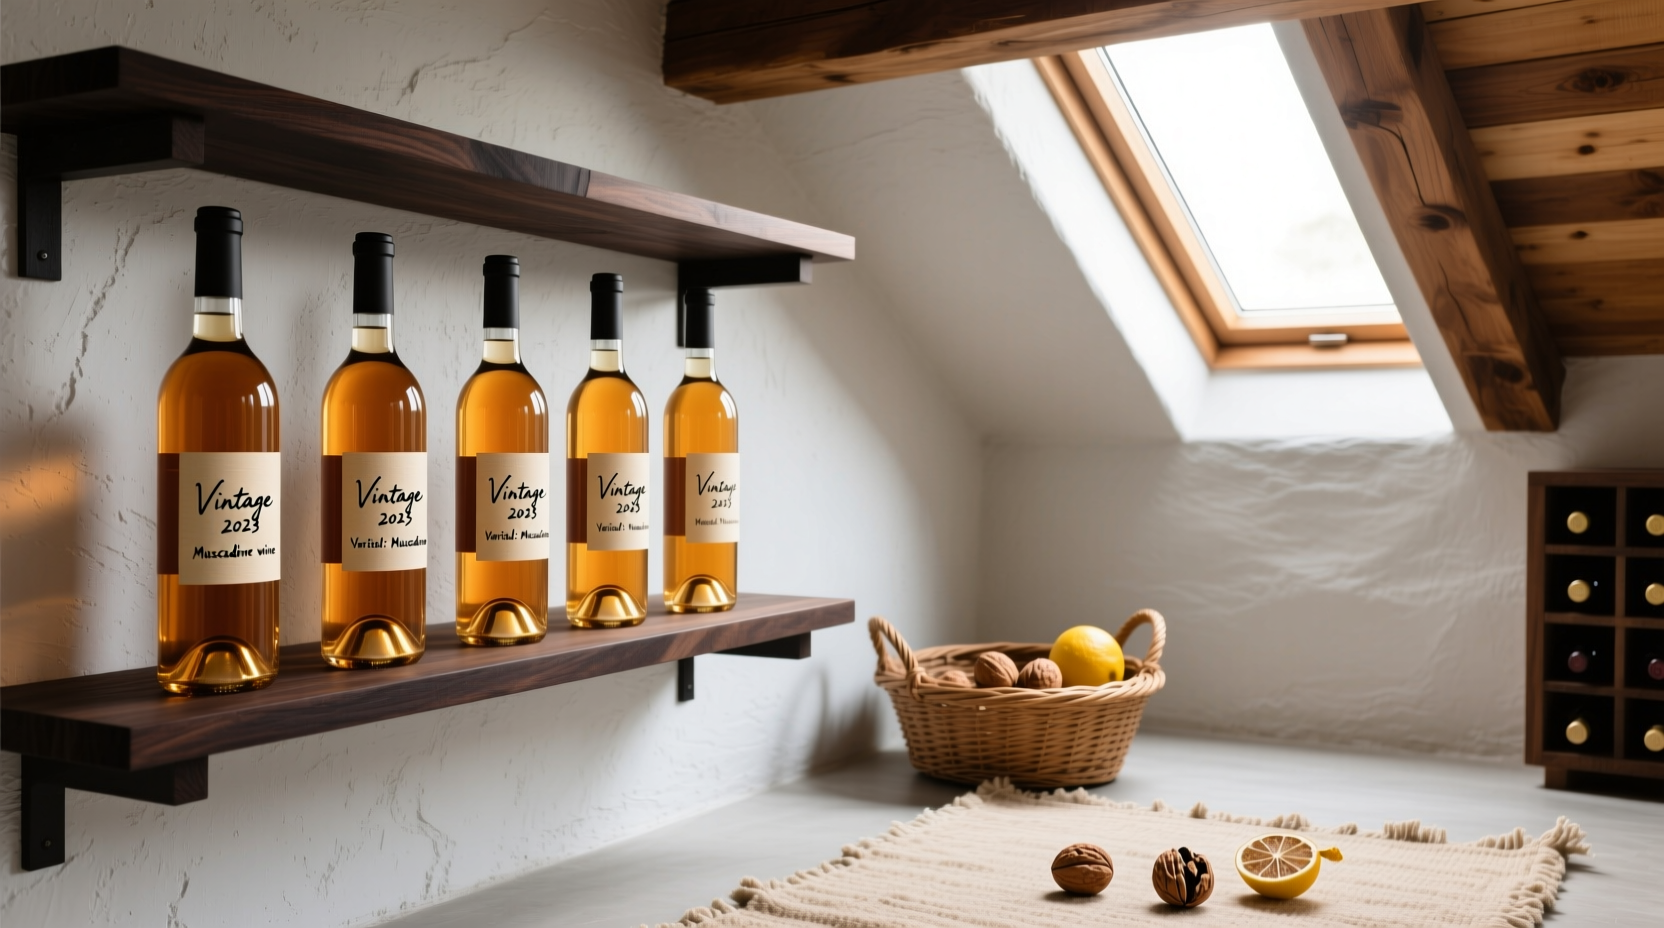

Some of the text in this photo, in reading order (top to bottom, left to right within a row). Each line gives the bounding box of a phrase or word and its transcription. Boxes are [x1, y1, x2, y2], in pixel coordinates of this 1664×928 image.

[195, 479, 273, 521] Vintage
[355, 475, 423, 514] Vintage
[488, 474, 546, 507] Vintage
[597, 472, 646, 505] Vintage
[220, 518, 260, 534] 2023
[377, 512, 413, 527] 2023
[507, 507, 537, 520] 2023
